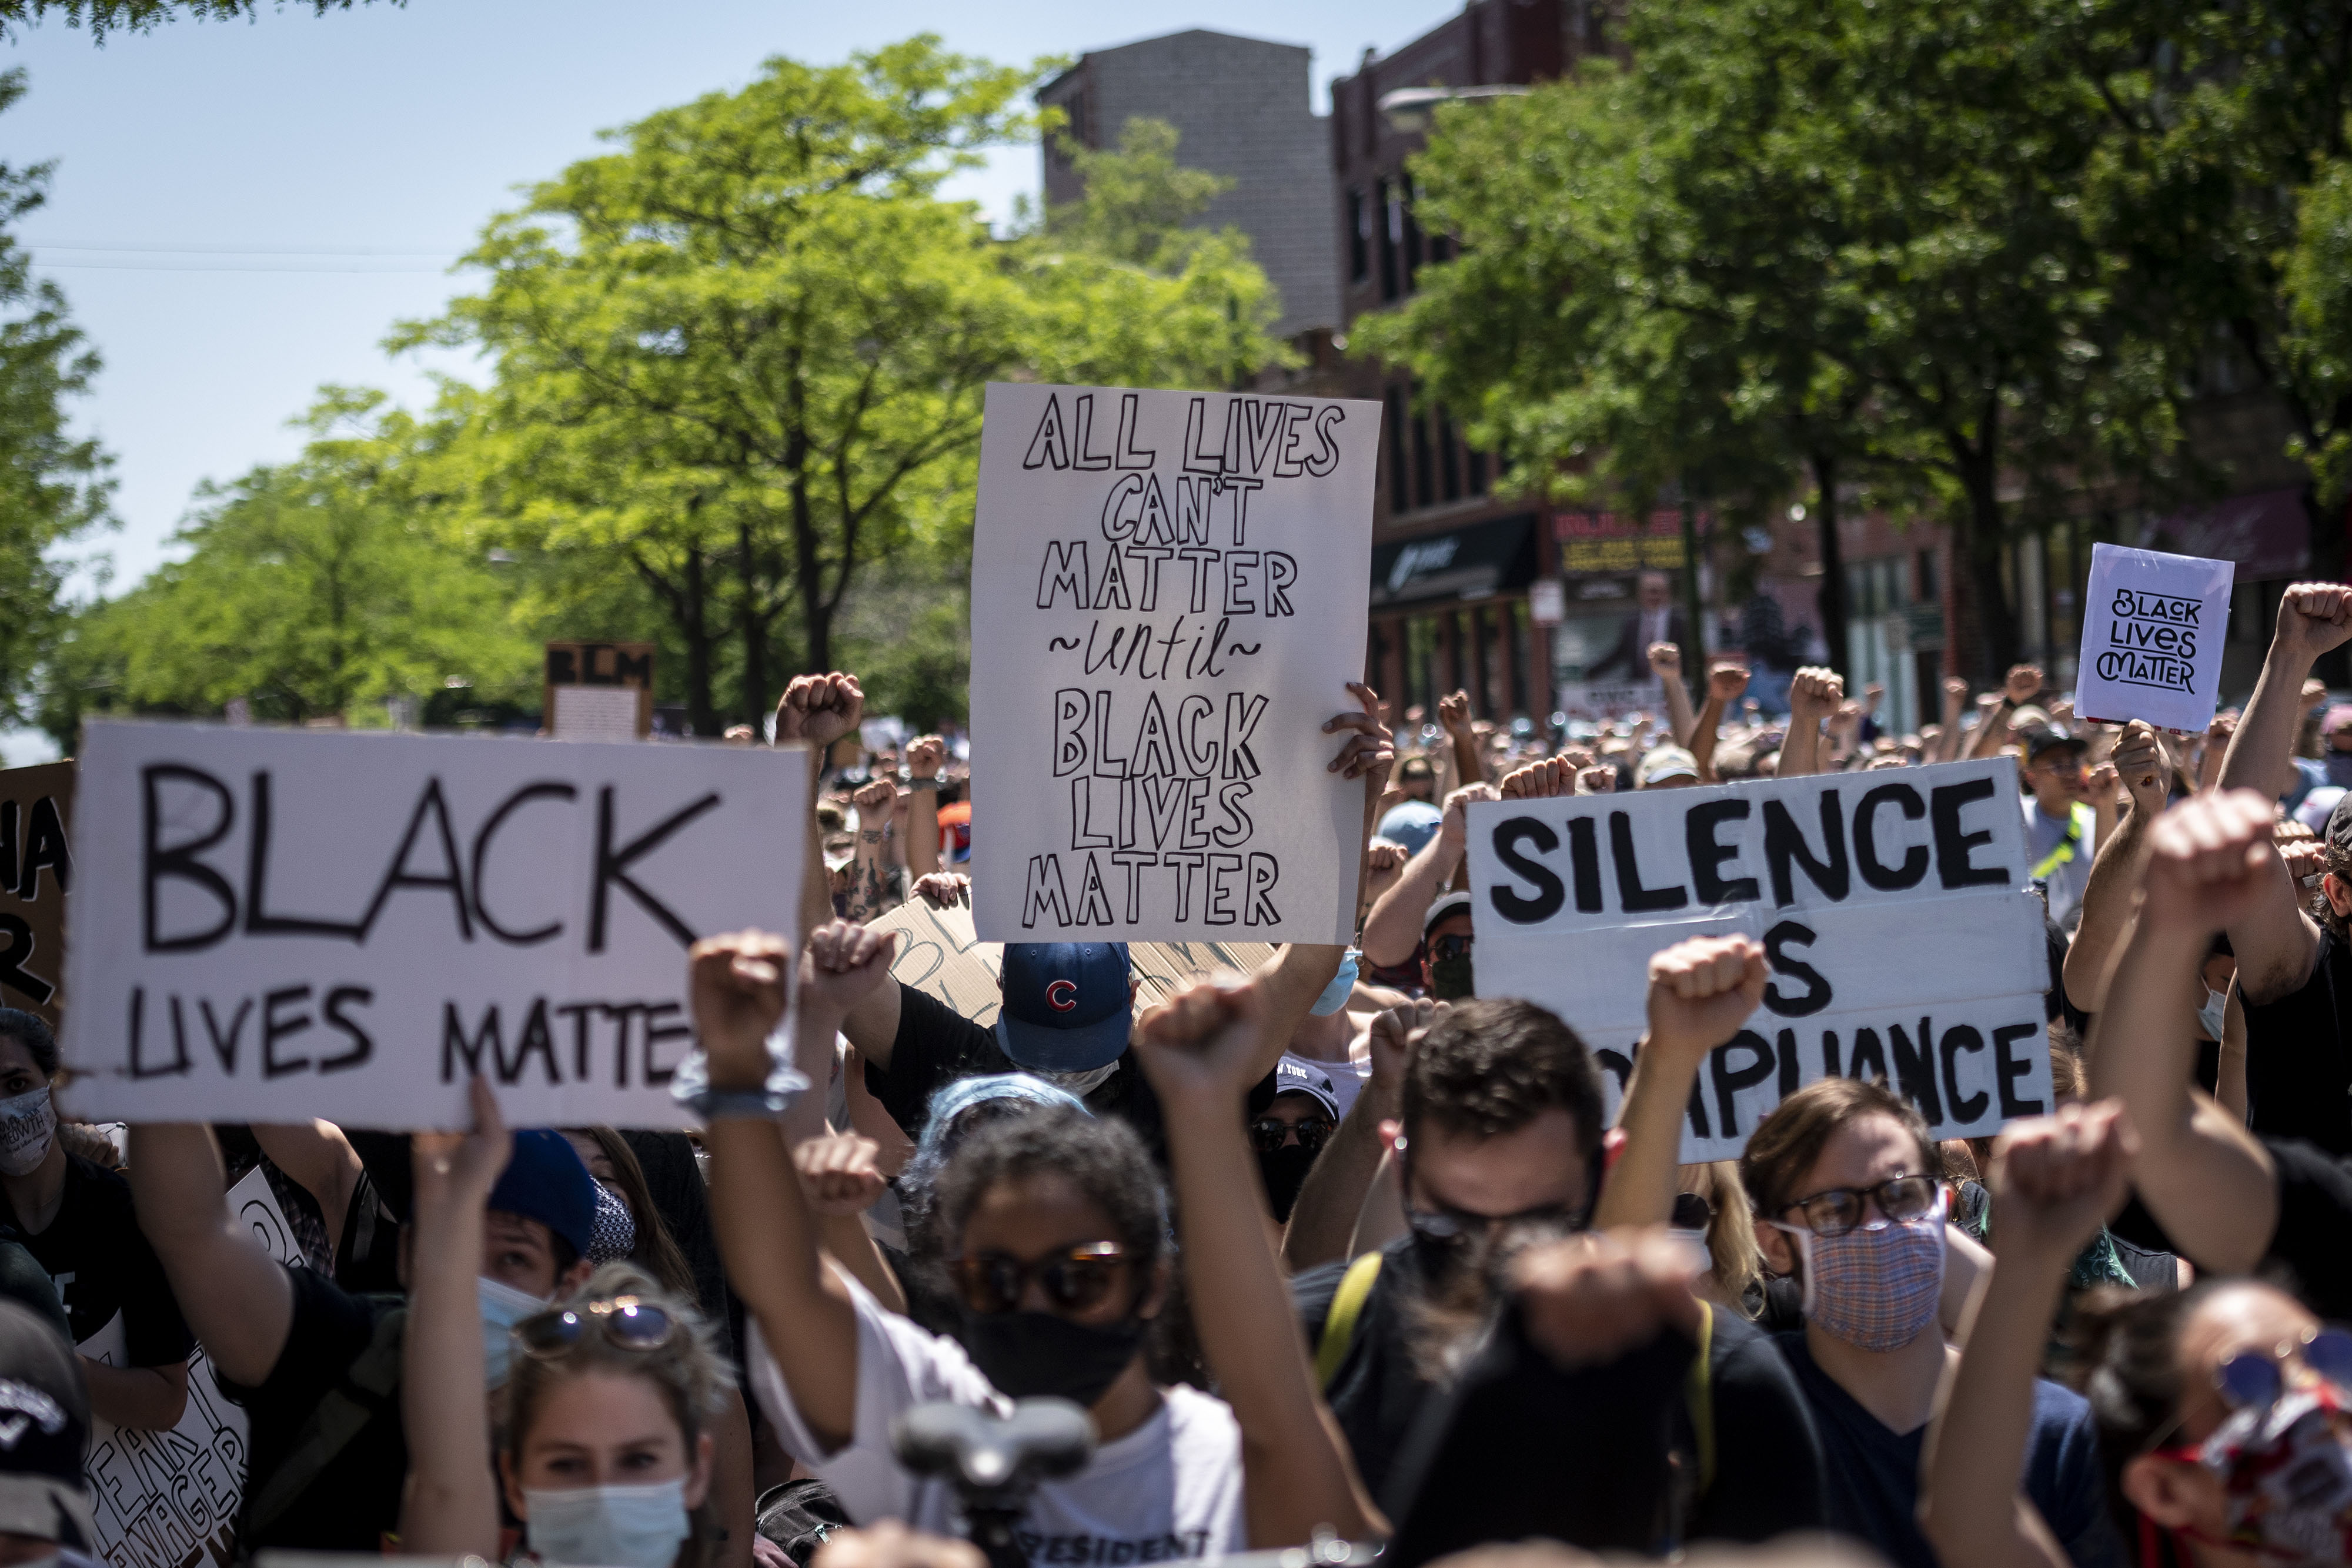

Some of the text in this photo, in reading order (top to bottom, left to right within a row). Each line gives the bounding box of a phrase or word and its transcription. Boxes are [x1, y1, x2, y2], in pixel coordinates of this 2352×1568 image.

[1023, 393, 1346, 478] ALL LIVES
[1101, 473, 1264, 546] CAN'T
[1037, 540, 1298, 618] MATTER
[2112, 588, 2201, 624] BLACK
[549, 645, 650, 689] BLM
[2096, 651, 2196, 695] MATTER
[1053, 687, 1269, 781] BLACK
[1071, 773, 1254, 851] LIVES
[1490, 777, 2010, 925] SILENCE
[141, 762, 721, 954] BLACK
[1022, 851, 1282, 929] MATTER
[1045, 979, 1077, 1013] C
[129, 984, 693, 1088] LIVES MATTE
[1286, 1064, 1308, 1079] YORK
